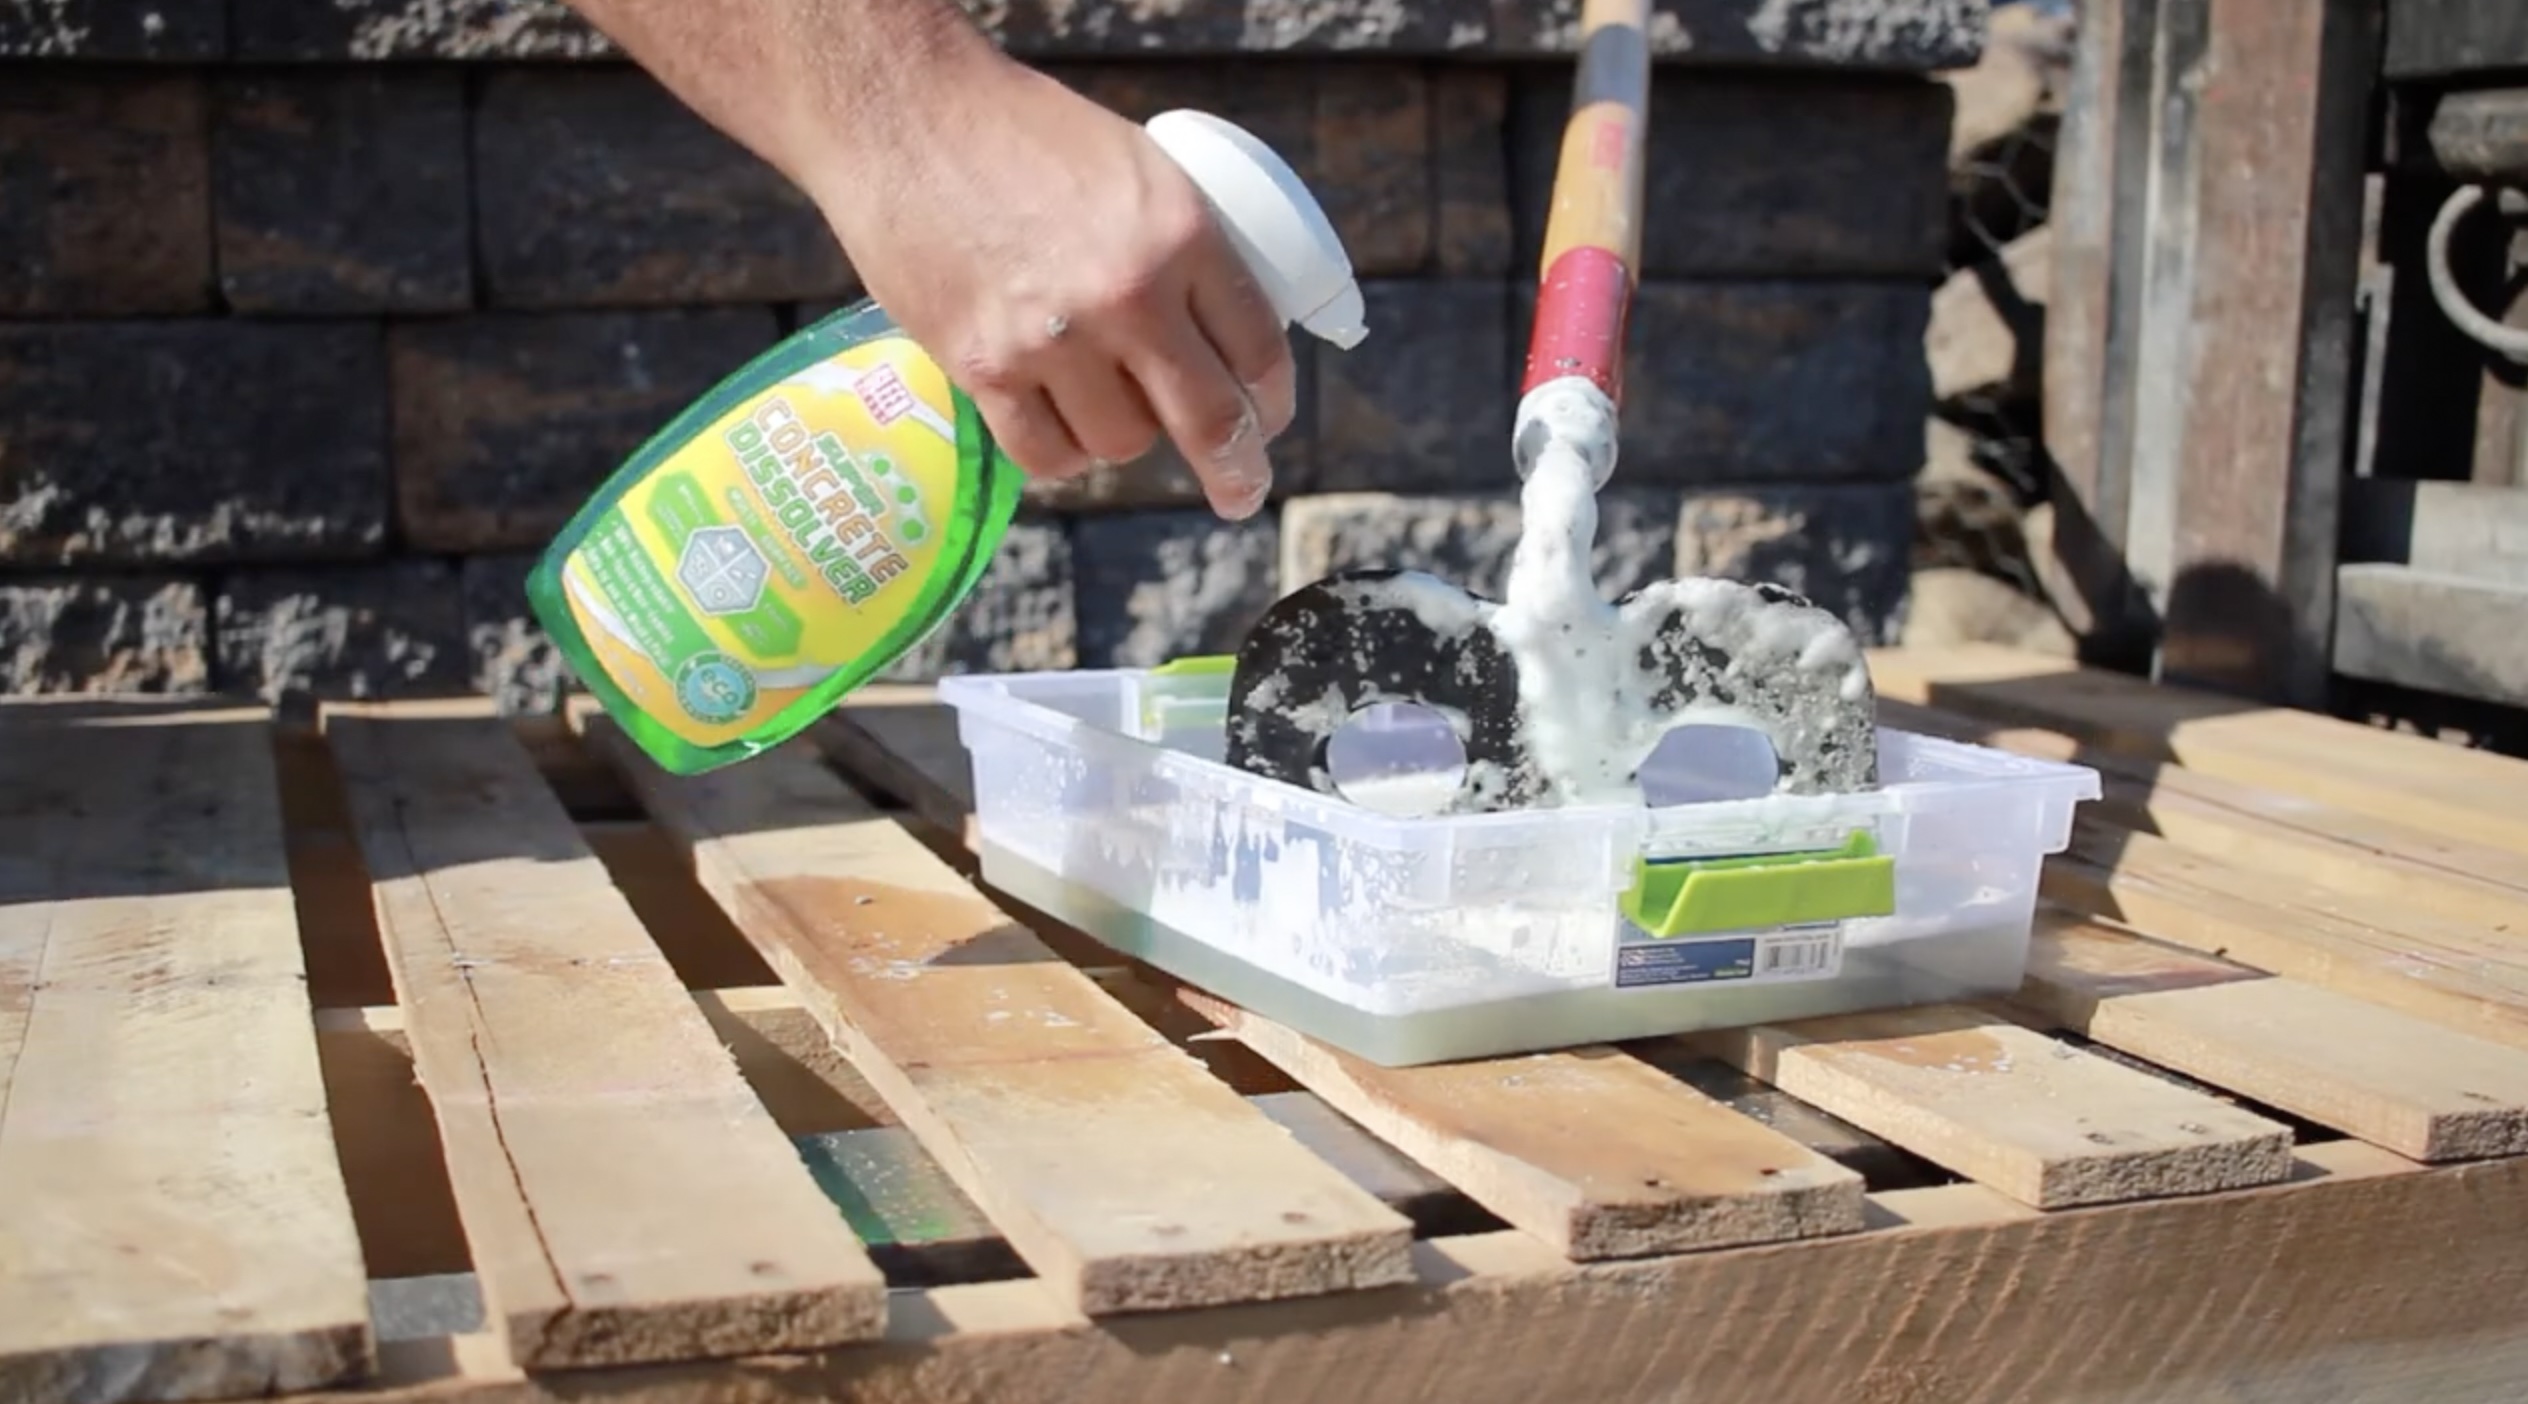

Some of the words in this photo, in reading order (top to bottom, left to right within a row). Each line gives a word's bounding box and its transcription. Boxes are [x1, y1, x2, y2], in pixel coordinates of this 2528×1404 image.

[726, 420, 877, 606] DISSOLVER
[754, 398, 908, 587] CONCRETE
[815, 432, 886, 518] SUPER
